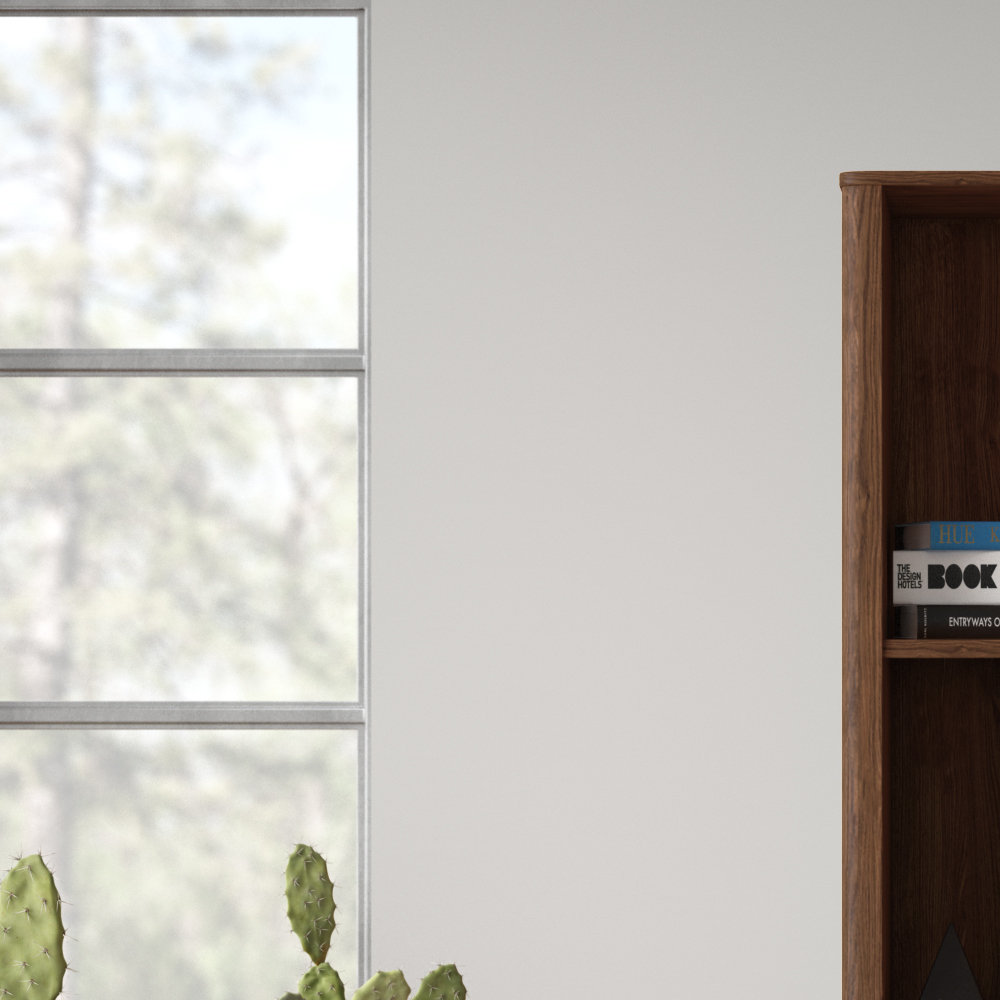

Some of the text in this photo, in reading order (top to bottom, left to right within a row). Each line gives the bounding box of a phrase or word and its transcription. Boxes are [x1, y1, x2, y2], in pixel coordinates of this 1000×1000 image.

[939, 524, 975, 544] HUE
[897, 563, 911, 573] THE
[897, 572, 922, 580] DESIGN
[927, 564, 998, 589] BOOK
[897, 580, 923, 589] HOTELS
[948, 616, 992, 628] ENTRYWAYS
